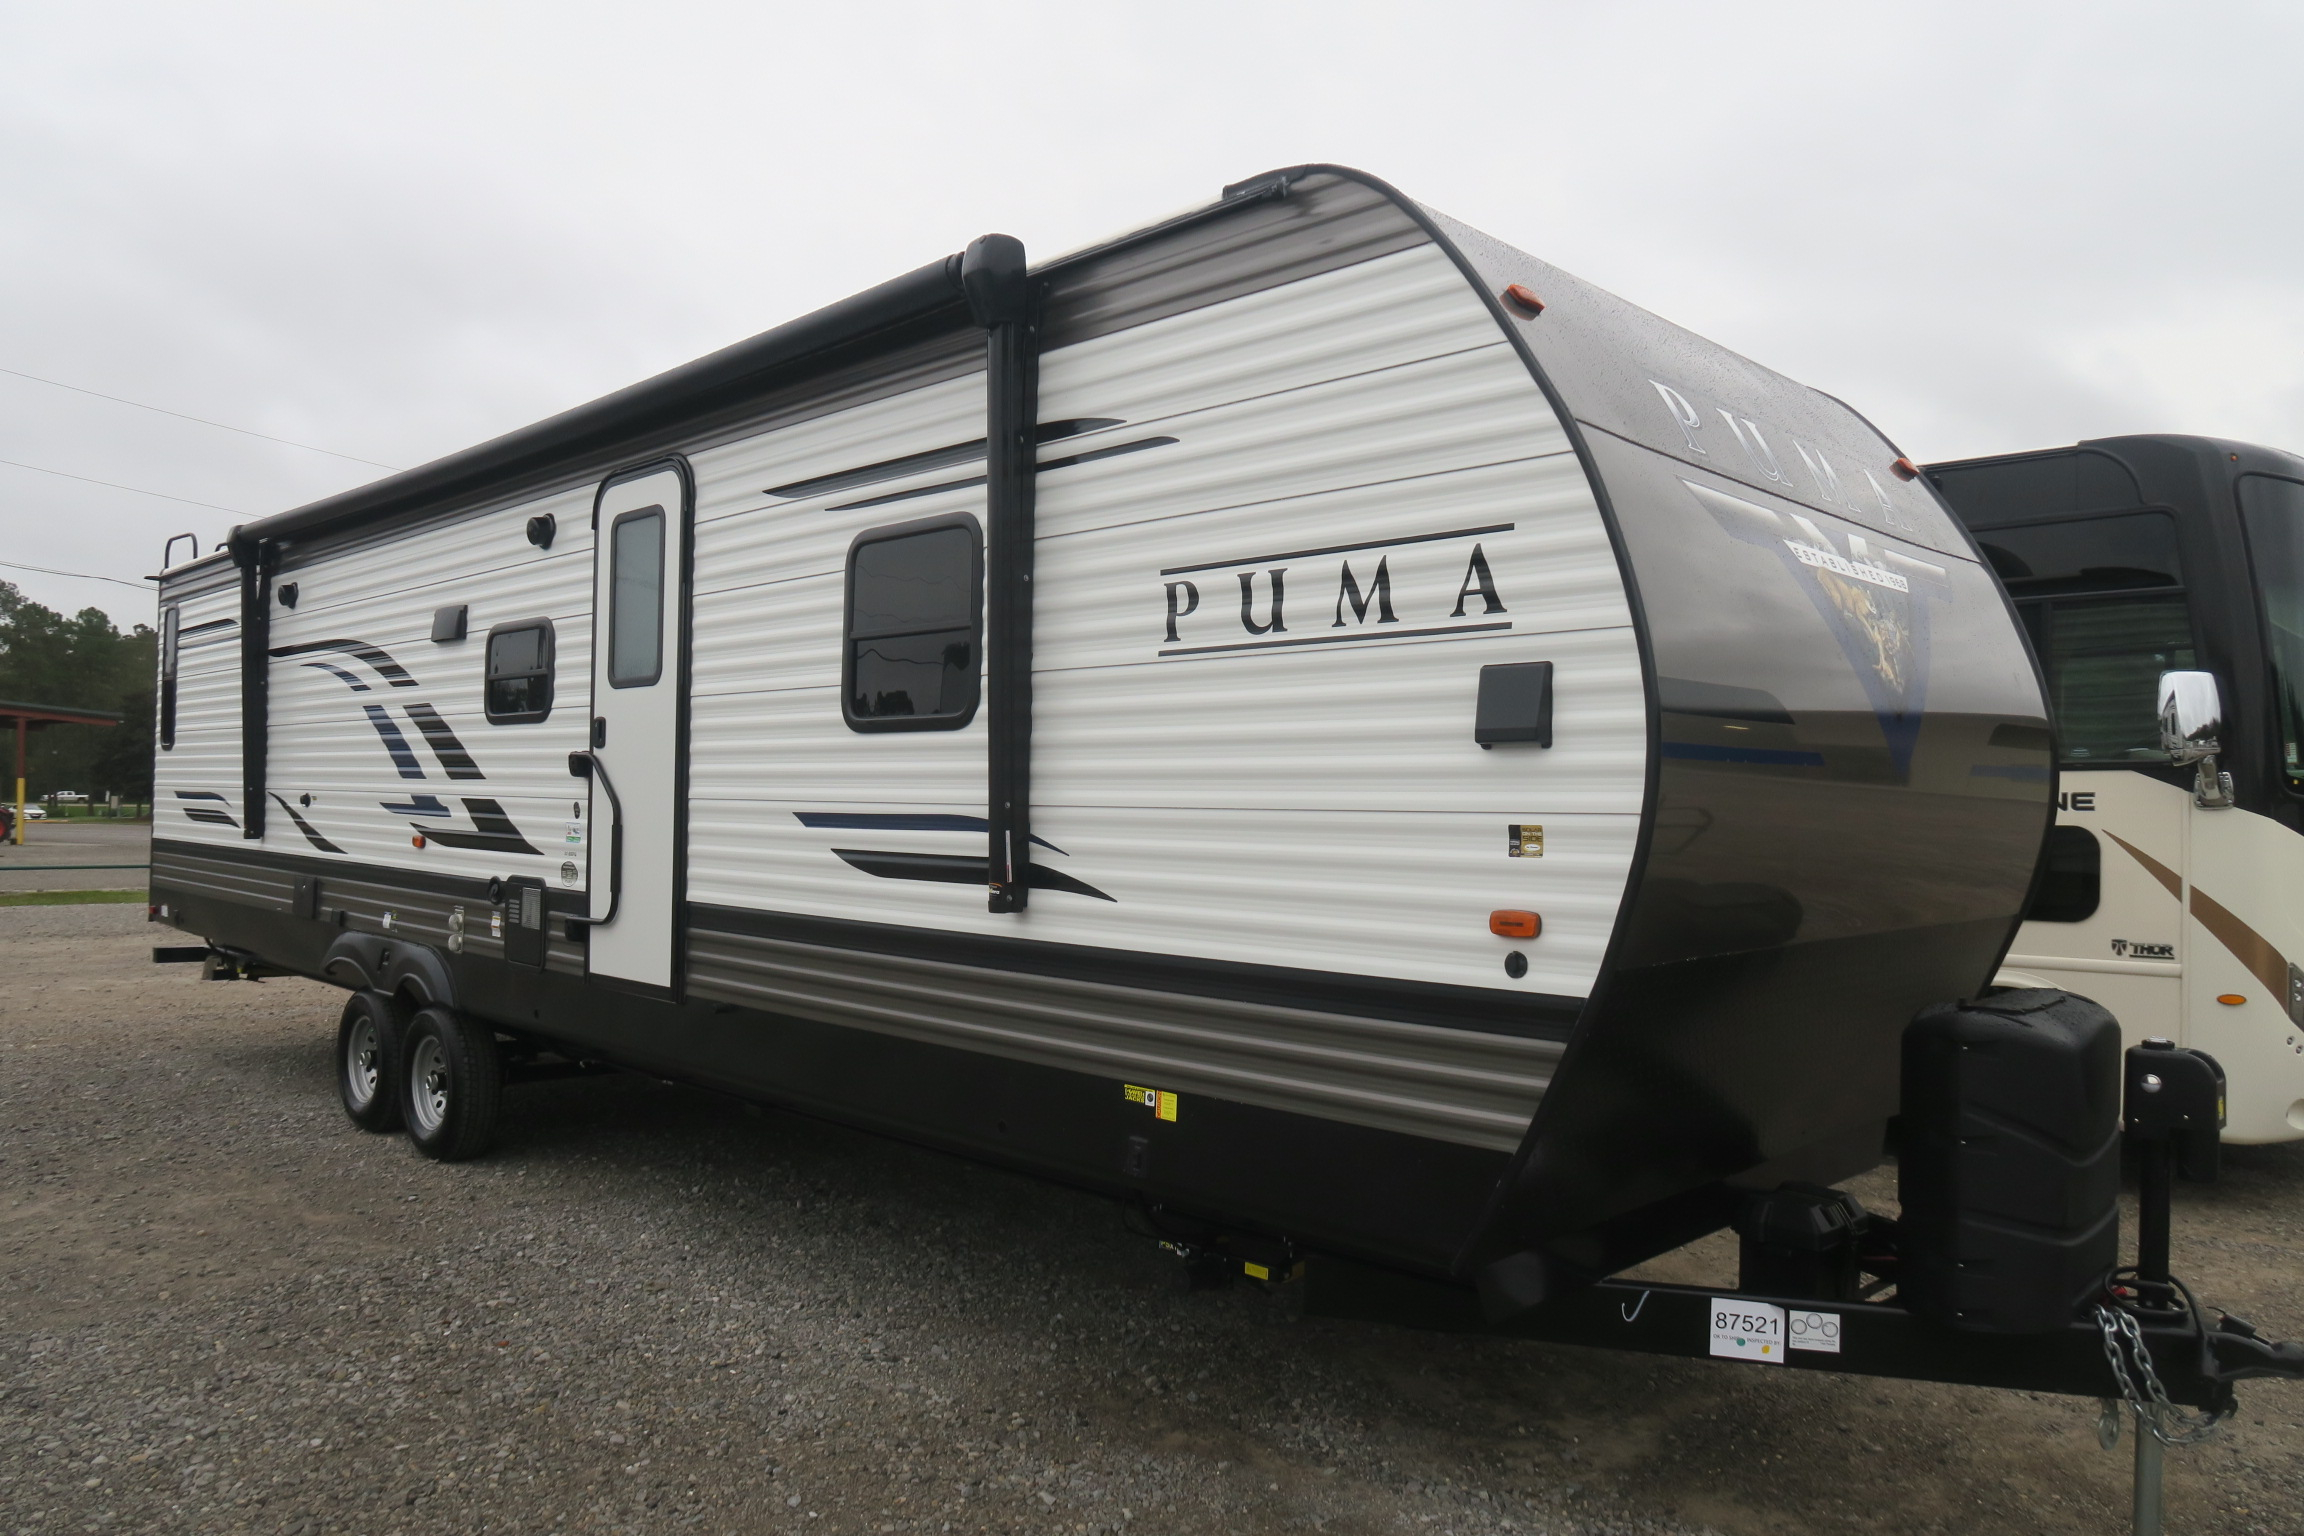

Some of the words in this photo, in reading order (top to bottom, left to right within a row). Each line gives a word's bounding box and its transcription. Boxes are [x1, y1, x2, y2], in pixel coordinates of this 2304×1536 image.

[1648, 379, 1913, 532] PUMA
[1793, 547, 1884, 583] ESTABLISHED
[1884, 575, 1908, 590] 1968
[1163, 543, 1508, 643] PUMA
[2129, 942, 2174, 956] THOR
[1715, 1312, 1777, 1336] 87521
[1747, 1337, 1773, 1345] INSPECTED
